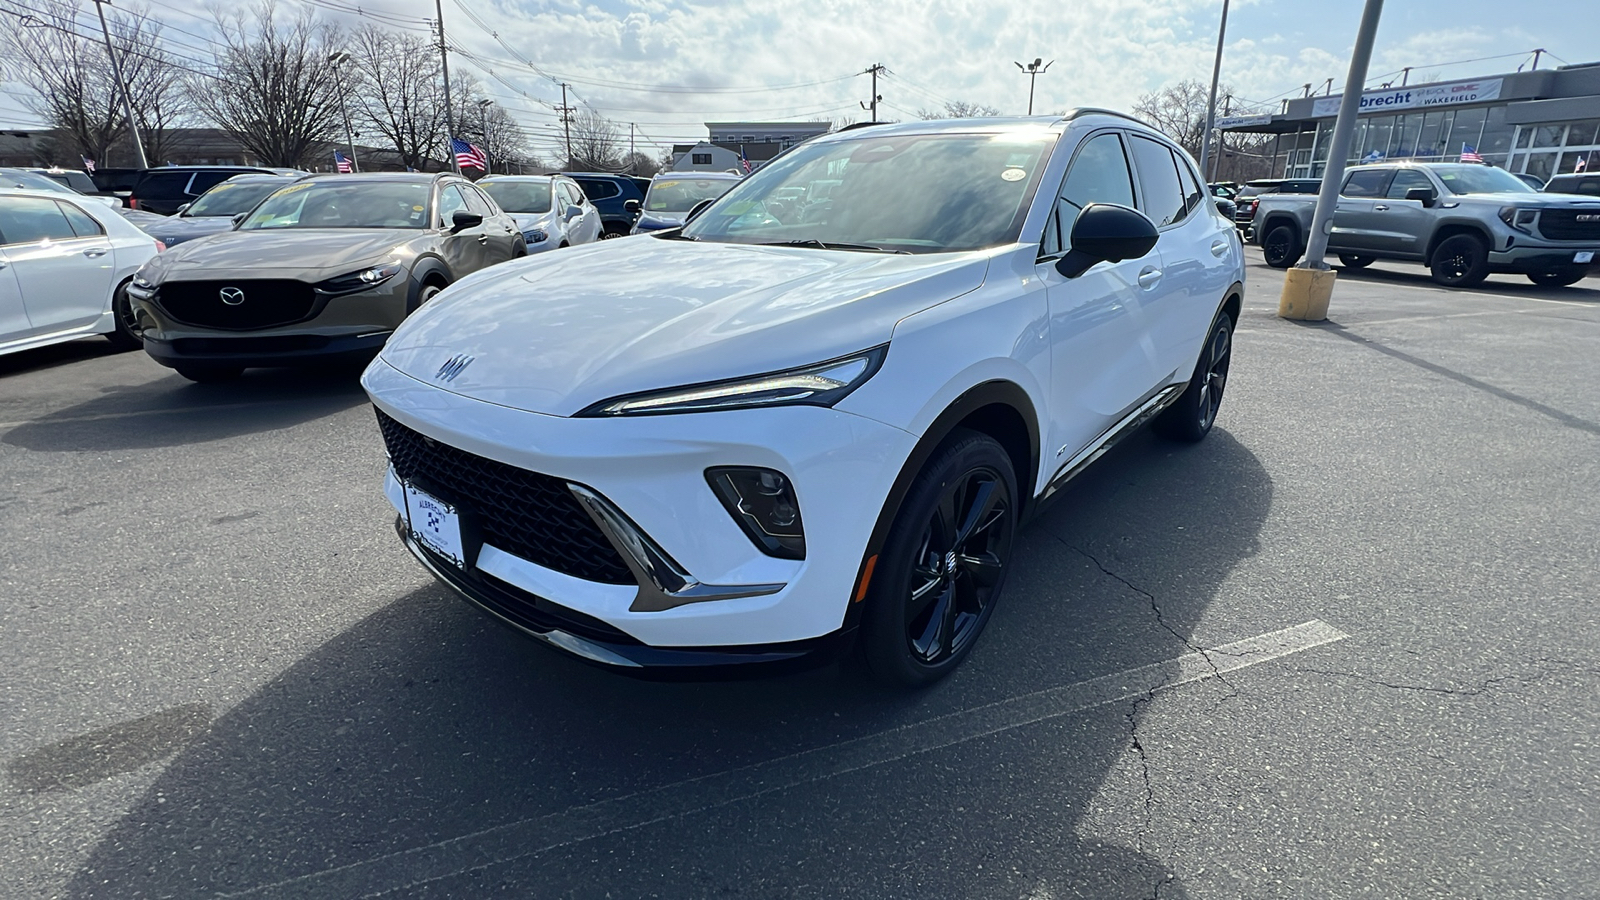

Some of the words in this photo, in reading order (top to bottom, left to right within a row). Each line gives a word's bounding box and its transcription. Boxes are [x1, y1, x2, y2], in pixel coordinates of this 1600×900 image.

[1452, 83, 1480, 93] GMC
[1359, 91, 1412, 107] brecht
[1424, 93, 1477, 105] WAKEFIELD
[419, 500, 446, 522] ALBRECHT
